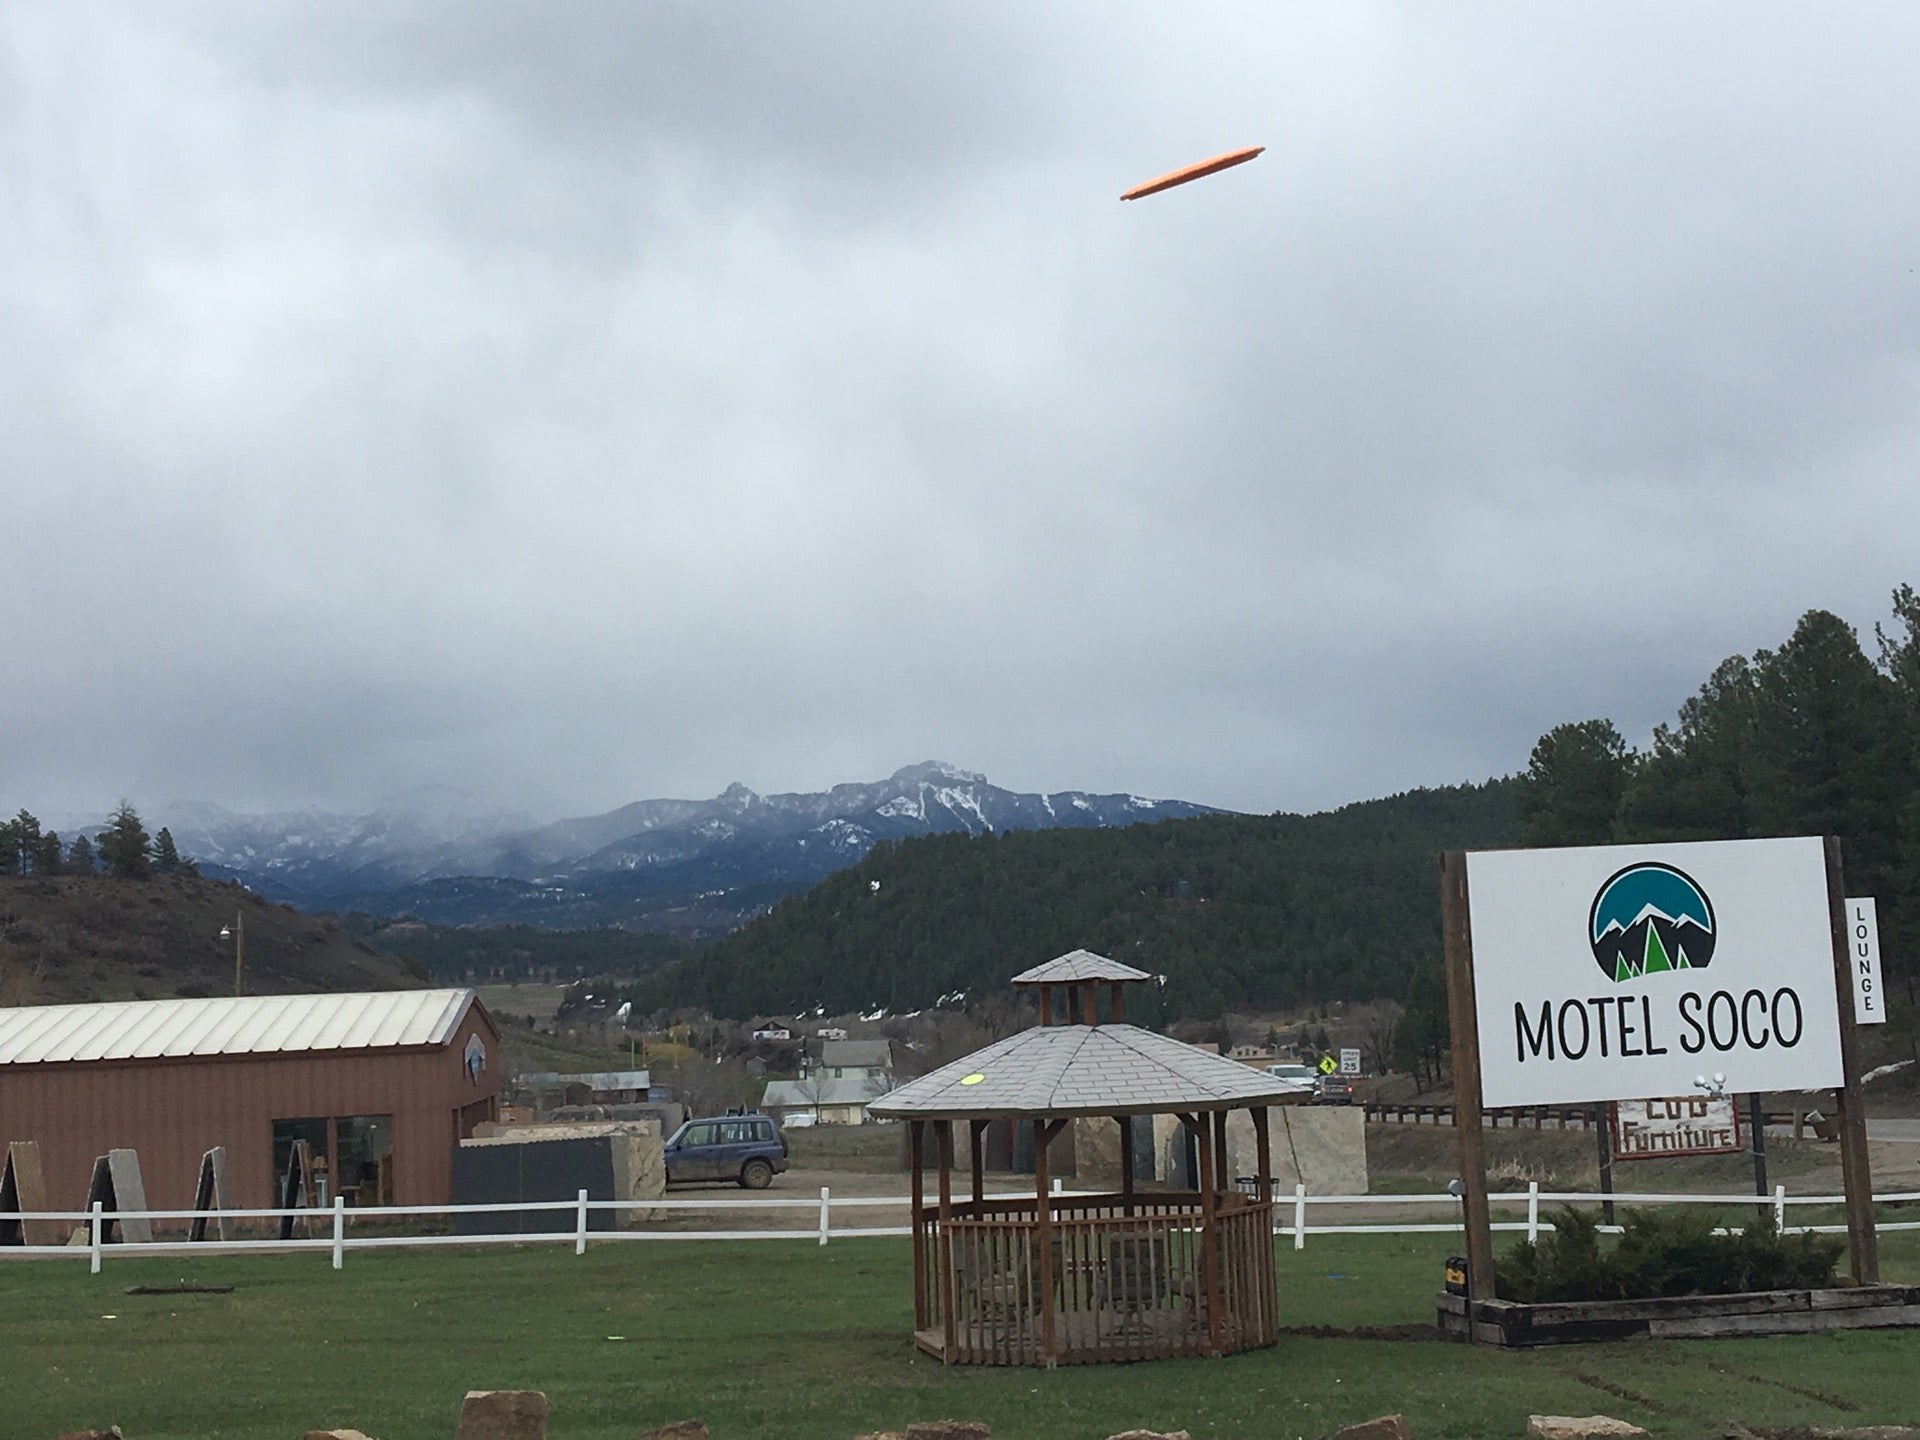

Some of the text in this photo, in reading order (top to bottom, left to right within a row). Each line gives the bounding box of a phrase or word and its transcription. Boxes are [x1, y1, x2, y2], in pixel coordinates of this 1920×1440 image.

[1856, 906, 1874, 1011] LOUNGE
[1514, 987, 1803, 1062] MOTEL SOCO
[1344, 1062, 1357, 1071] 25
[1623, 1121, 1732, 1152] Furniture
